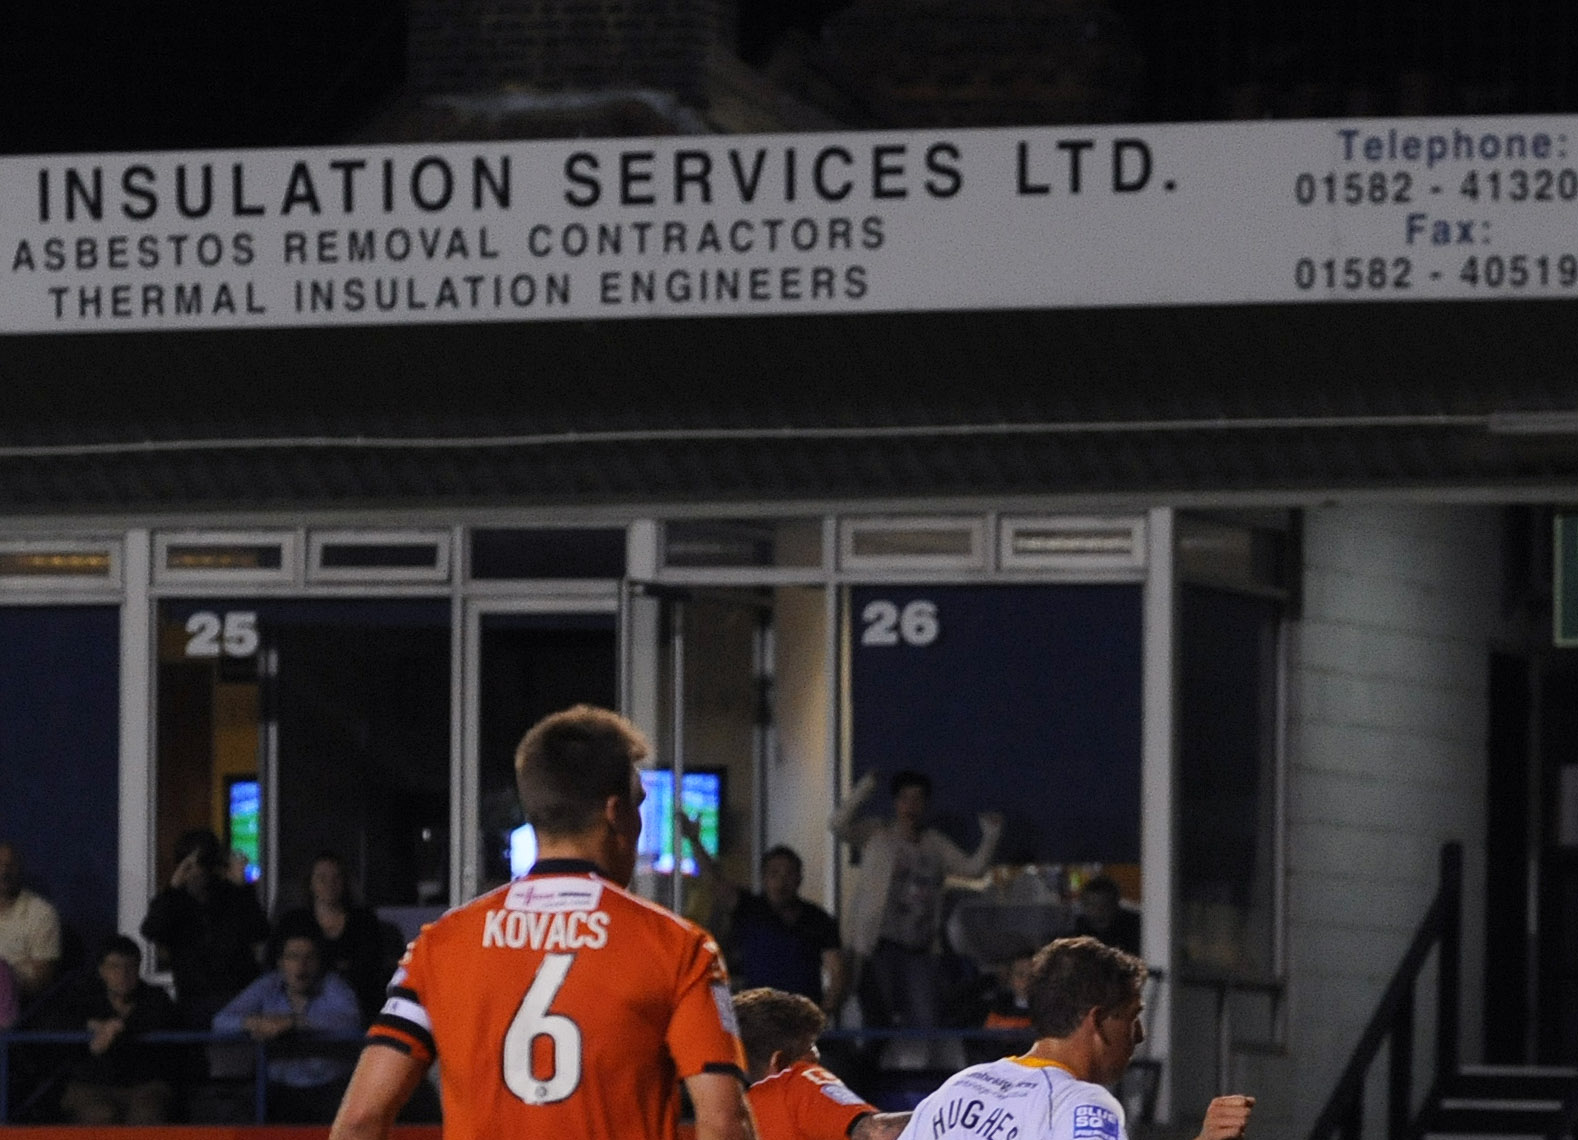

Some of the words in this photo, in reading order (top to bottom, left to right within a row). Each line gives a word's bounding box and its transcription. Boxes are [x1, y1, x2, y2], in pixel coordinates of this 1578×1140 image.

[1337, 127, 1567, 167] Telephone:
[38, 153, 512, 222] INSULATION
[562, 141, 964, 206] SERVICES
[1016, 137, 1178, 197] LTD.
[1294, 170, 1414, 206] 01582
[12, 231, 256, 273] ASBESTOS
[283, 225, 500, 265] REMOVAL
[527, 215, 886, 257] CONTRACTORS
[1405, 211, 1493, 246] Fax:
[48, 283, 268, 320] THERMAL
[294, 273, 572, 313] INSULATION
[599, 265, 870, 304] ENGINEERS
[1294, 255, 1414, 292] 01582
[185, 611, 259, 658] 25
[861, 600, 940, 647] 26
[481, 908, 611, 951] KOVACS
[501, 951, 583, 1106] 6
